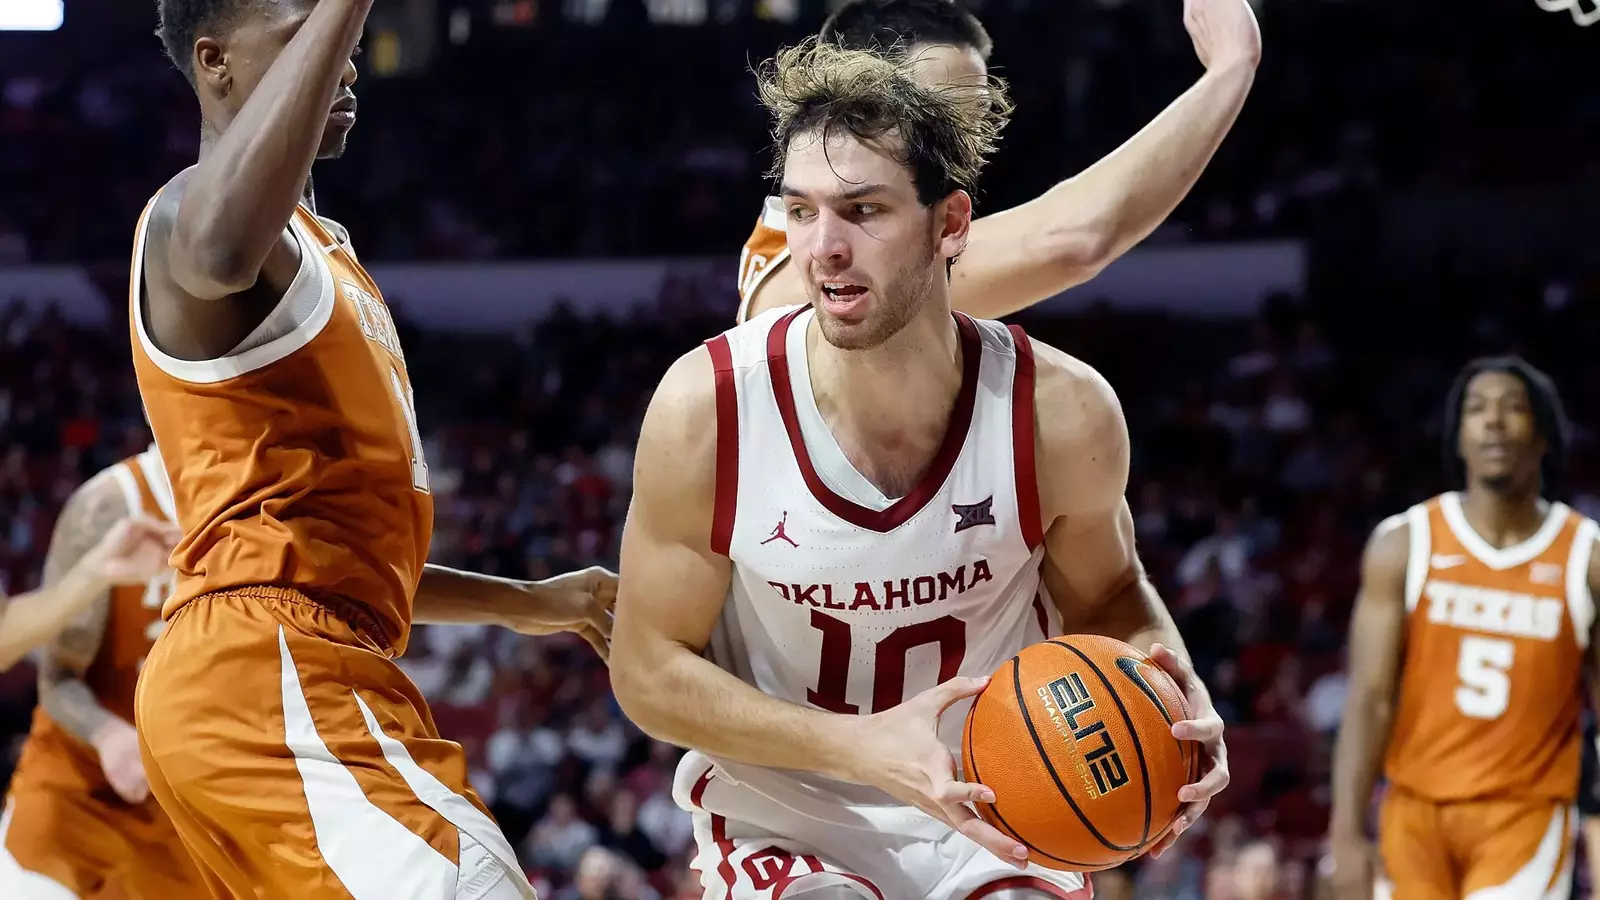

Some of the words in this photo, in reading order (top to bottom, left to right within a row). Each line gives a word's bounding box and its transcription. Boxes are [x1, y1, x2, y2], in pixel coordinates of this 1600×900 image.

[1426, 579, 1565, 642] TEXAS
[806, 609, 967, 716] 10
[1454, 635, 1516, 720] 5
[1047, 671, 1131, 797] ELITE
